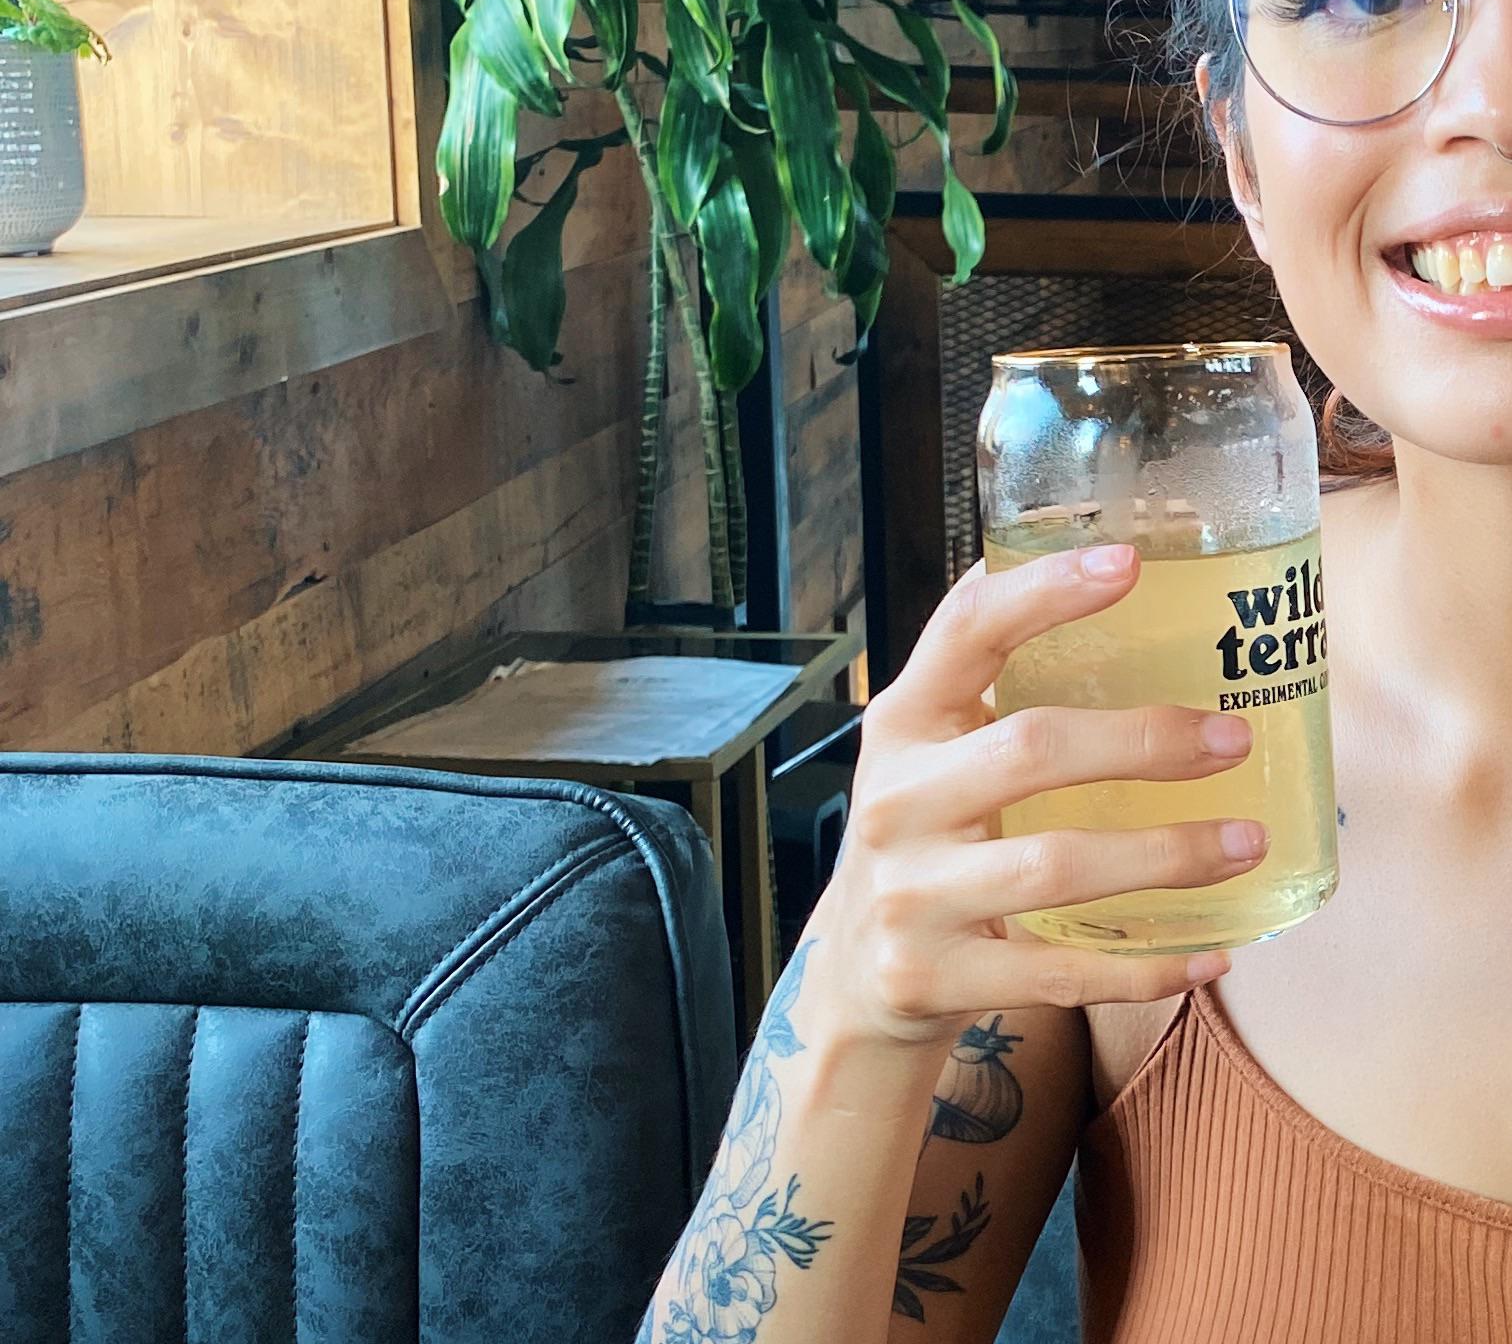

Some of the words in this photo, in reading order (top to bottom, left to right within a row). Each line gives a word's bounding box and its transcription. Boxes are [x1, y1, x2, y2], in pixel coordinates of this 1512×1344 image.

[1227, 556, 1325, 629] wild
[1216, 618, 1328, 681] terra
[1219, 675, 1319, 711] EXPERIMENTAL
